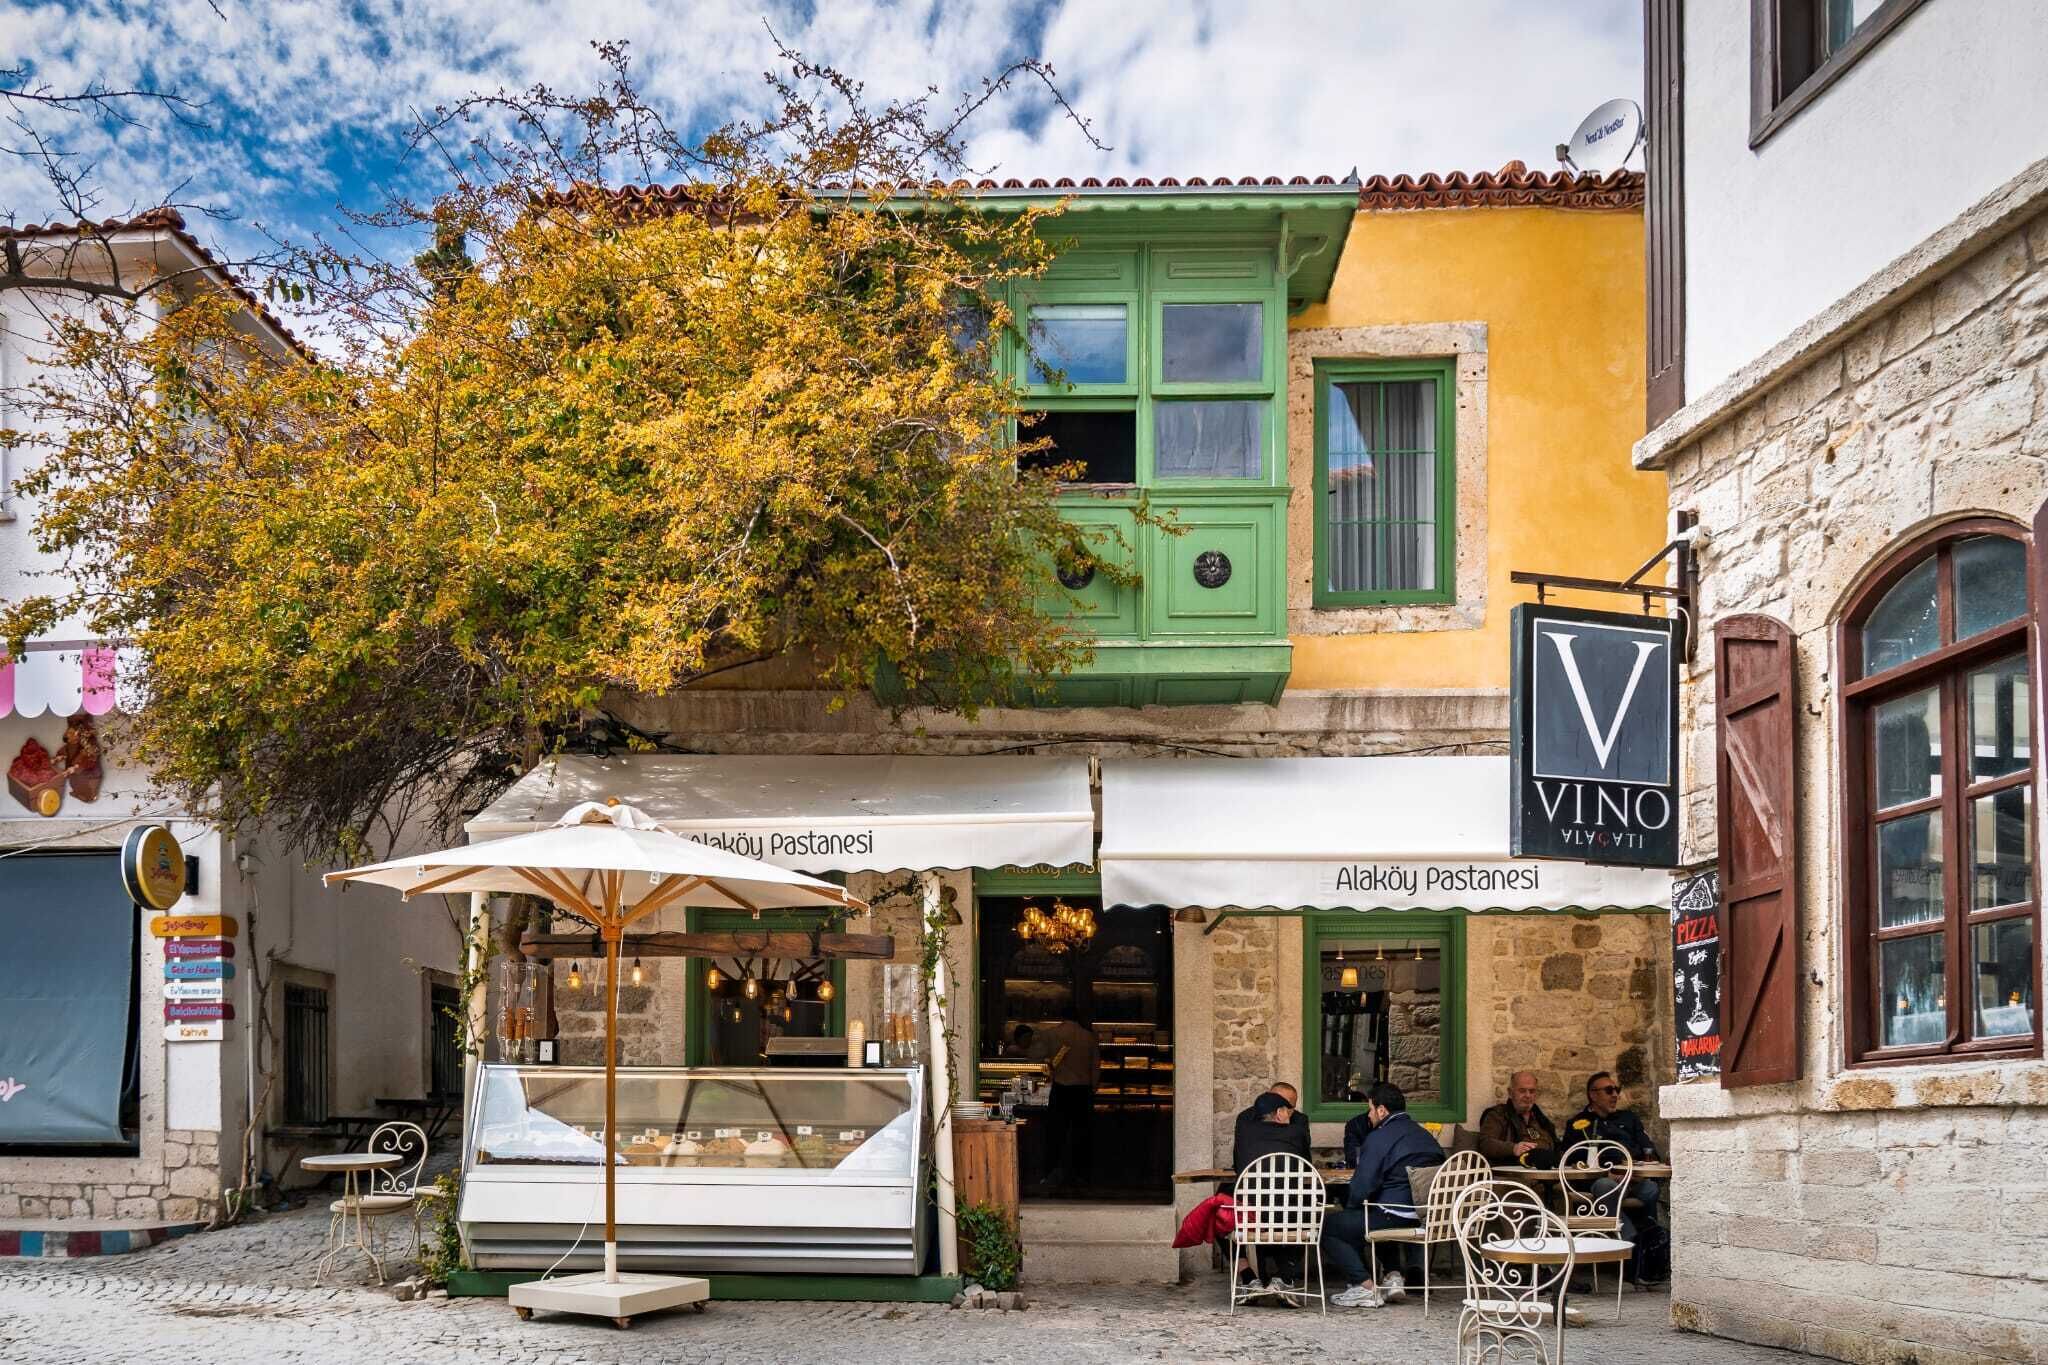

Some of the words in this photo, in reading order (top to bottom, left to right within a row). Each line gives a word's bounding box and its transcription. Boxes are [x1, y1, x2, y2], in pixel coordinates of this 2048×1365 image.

[1541, 631, 1663, 770] V
[1532, 780, 1671, 830] VINO
[771, 830, 873, 855] Pastanesi
[1336, 865, 1417, 896] Alaköy
[1426, 865, 1540, 890] Pastanesi
[180, 1028, 208, 1037] Kahve
